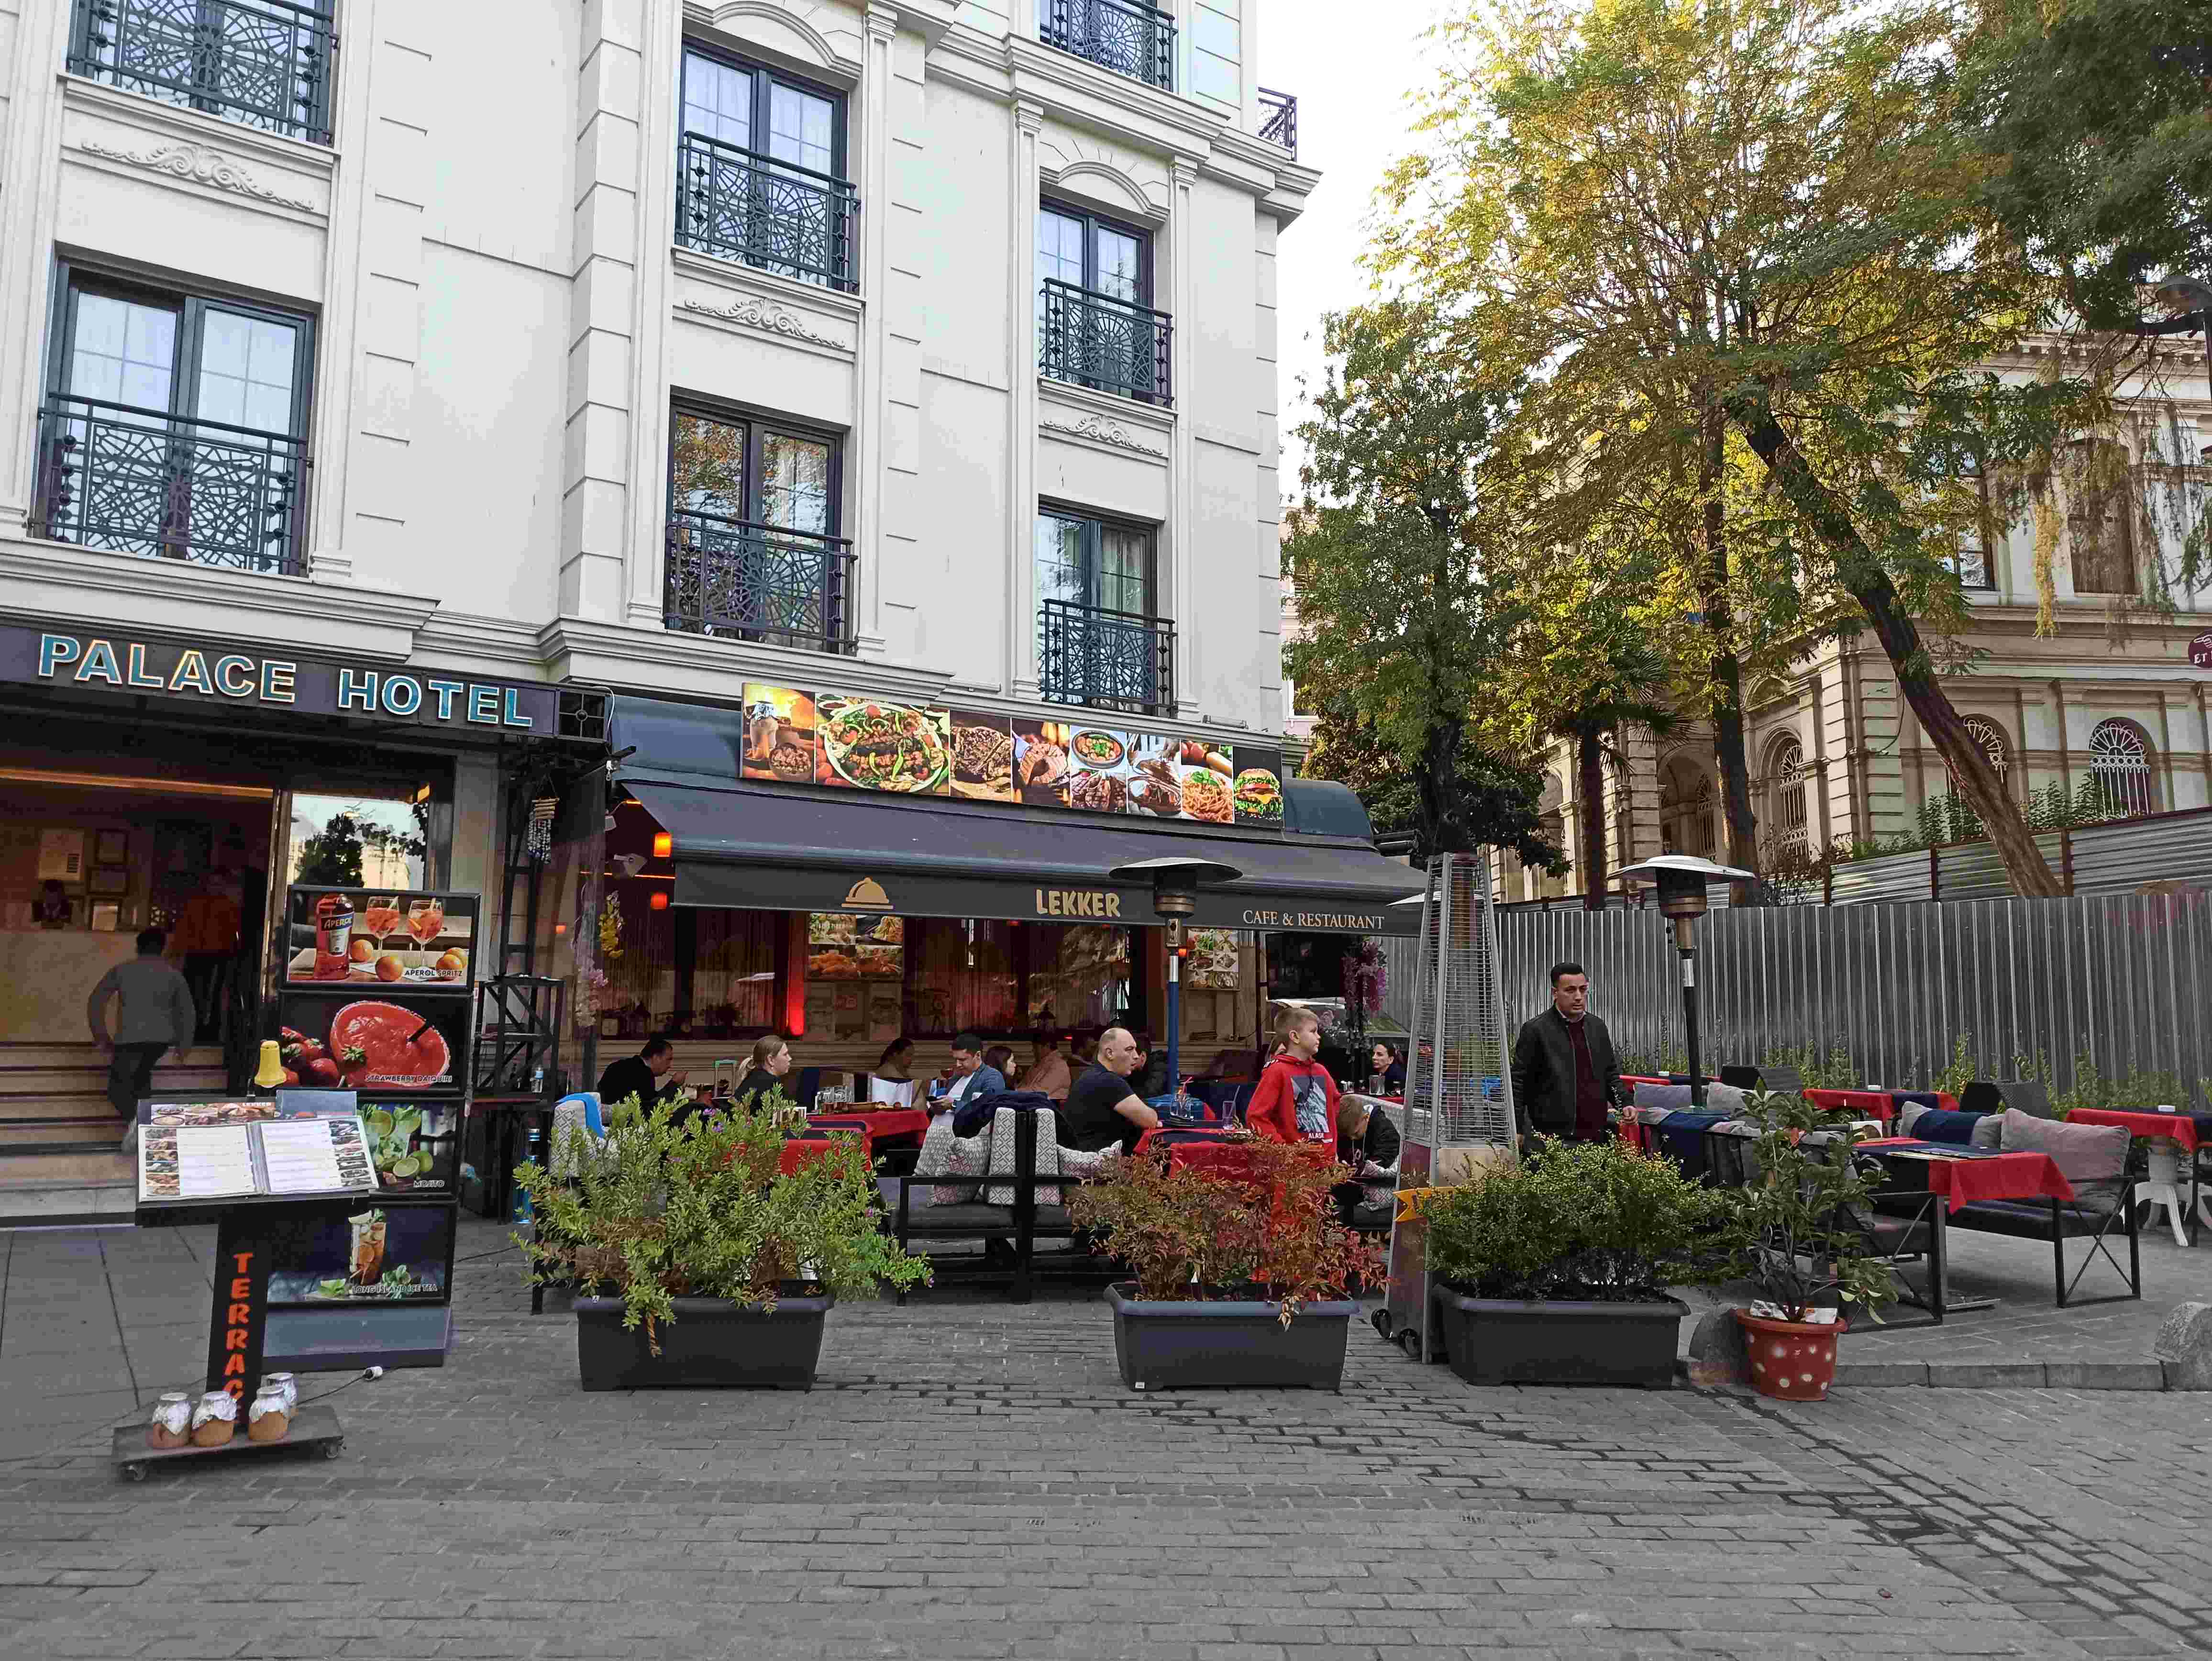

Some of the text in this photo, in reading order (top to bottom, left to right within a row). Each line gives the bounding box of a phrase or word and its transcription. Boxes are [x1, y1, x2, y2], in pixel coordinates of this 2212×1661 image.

[38, 633, 532, 727] PALACE HOTEL
[1036, 889, 1121, 918] LEKKER
[1243, 910, 1385, 930] CAFE & RESTAURANT
[413, 1179, 445, 1188] MOJITO
[352, 1285, 376, 1294] LONG
[222, 1252, 254, 1414] TERRAC
